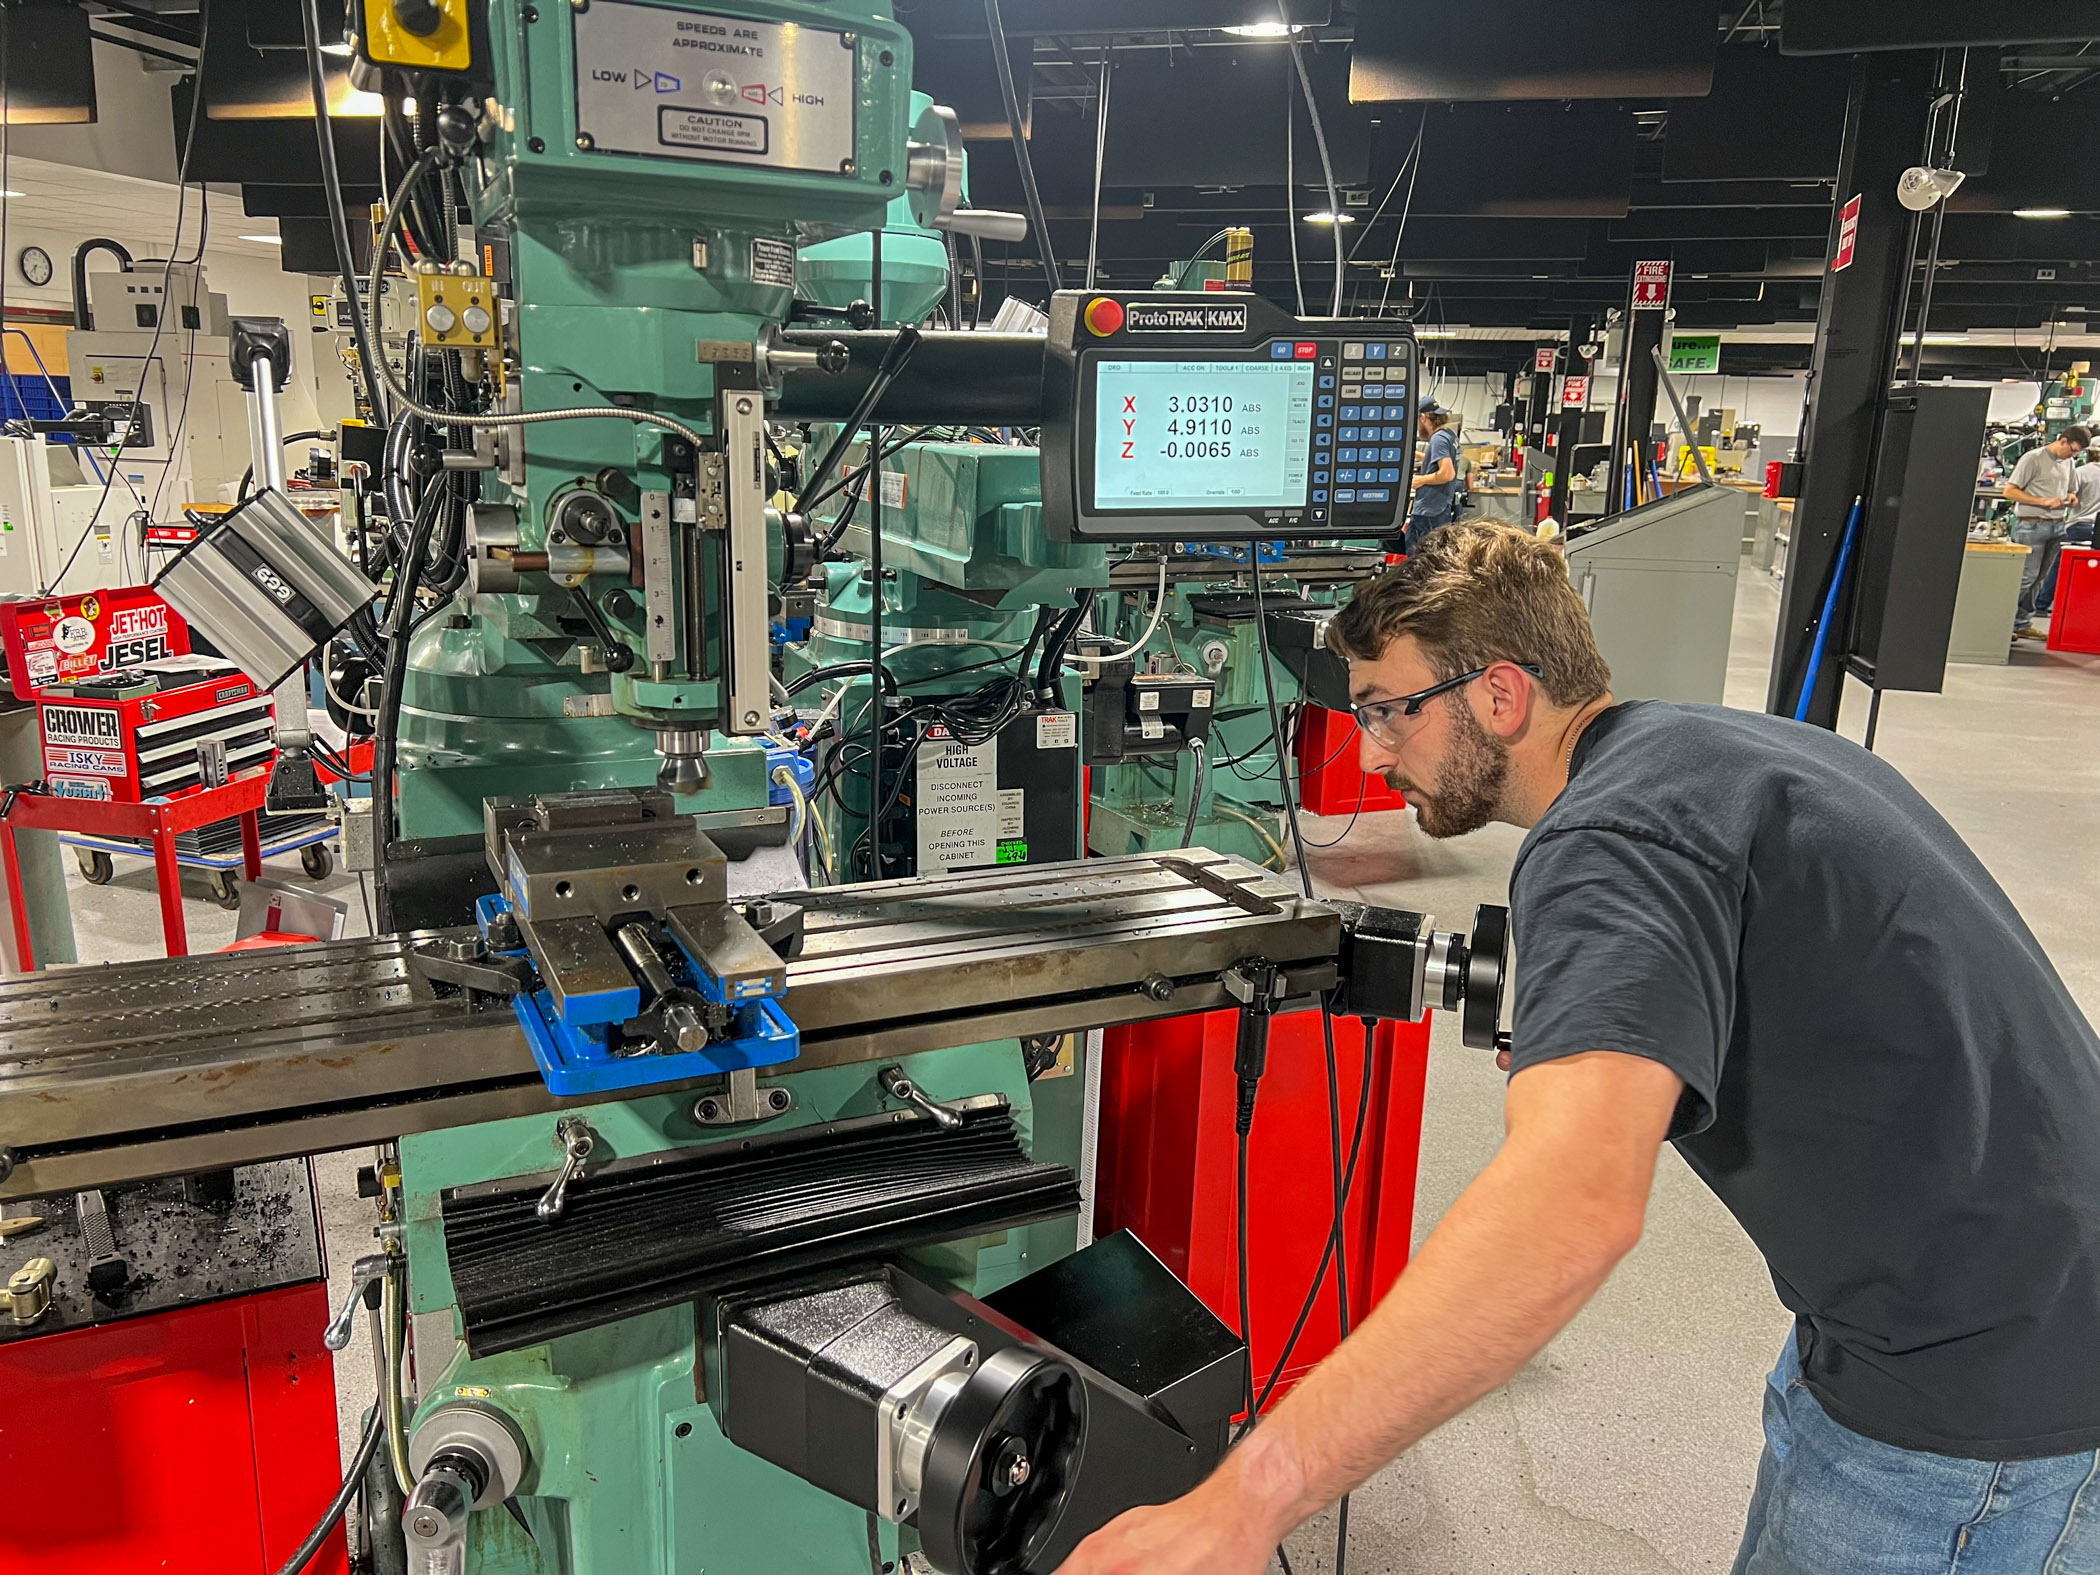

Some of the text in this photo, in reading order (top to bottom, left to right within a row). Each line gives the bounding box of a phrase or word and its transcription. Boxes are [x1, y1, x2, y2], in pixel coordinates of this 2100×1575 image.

[676, 21, 758, 40] SPEEDS ARE
[672, 38, 764, 58] APPROXIMATE
[592, 69, 628, 83] LOW
[792, 94, 824, 106] HIGH
[688, 115, 742, 128] CAUTION
[707, 128, 734, 136] CHANGE
[671, 132, 758, 146] WITHOUT MOTOR RUNNING
[1644, 266, 1664, 275] FIRE
[462, 280, 486, 294] OUT
[1129, 310, 1244, 327] ProtoTRAK KMX
[1349, 346, 1358, 356] X
[1373, 346, 1380, 356] Y
[1394, 346, 1402, 356] Z
[1122, 396, 1262, 413] X 3.0310 ABS
[1347, 409, 1354, 418] 7
[1368, 409, 1375, 418] 8
[1390, 409, 1396, 418] 9
[1122, 418, 1260, 436] Y 4.9110 ABS
[1346, 430, 1352, 438] 4
[1368, 430, 1374, 438] 5
[1389, 430, 1395, 438] 6
[1121, 442, 1260, 458] Z -0.0065 ABS
[1345, 450, 1350, 459] 1
[1366, 450, 1372, 458] 2
[1388, 450, 1394, 458] 3
[1364, 471, 1371, 480] 0
[101, 637, 171, 670] JESEL
[64, 655, 96, 670] BILLET
[45, 708, 118, 737] CROWER
[48, 734, 119, 746] RACING PRODUCTS
[946, 744, 968, 756] HIGH
[70, 752, 102, 765] ISKY
[936, 756, 978, 768] VOLTAGE
[50, 762, 89, 770] RACING
[931, 780, 984, 790] DISCONNECT
[936, 793, 978, 802] INCOMING
[918, 804, 996, 815] POWER SOURCE(S)
[940, 828, 974, 838] BEFORE
[928, 839, 986, 850] OPENING THIS
[939, 852, 974, 861] CABINET
